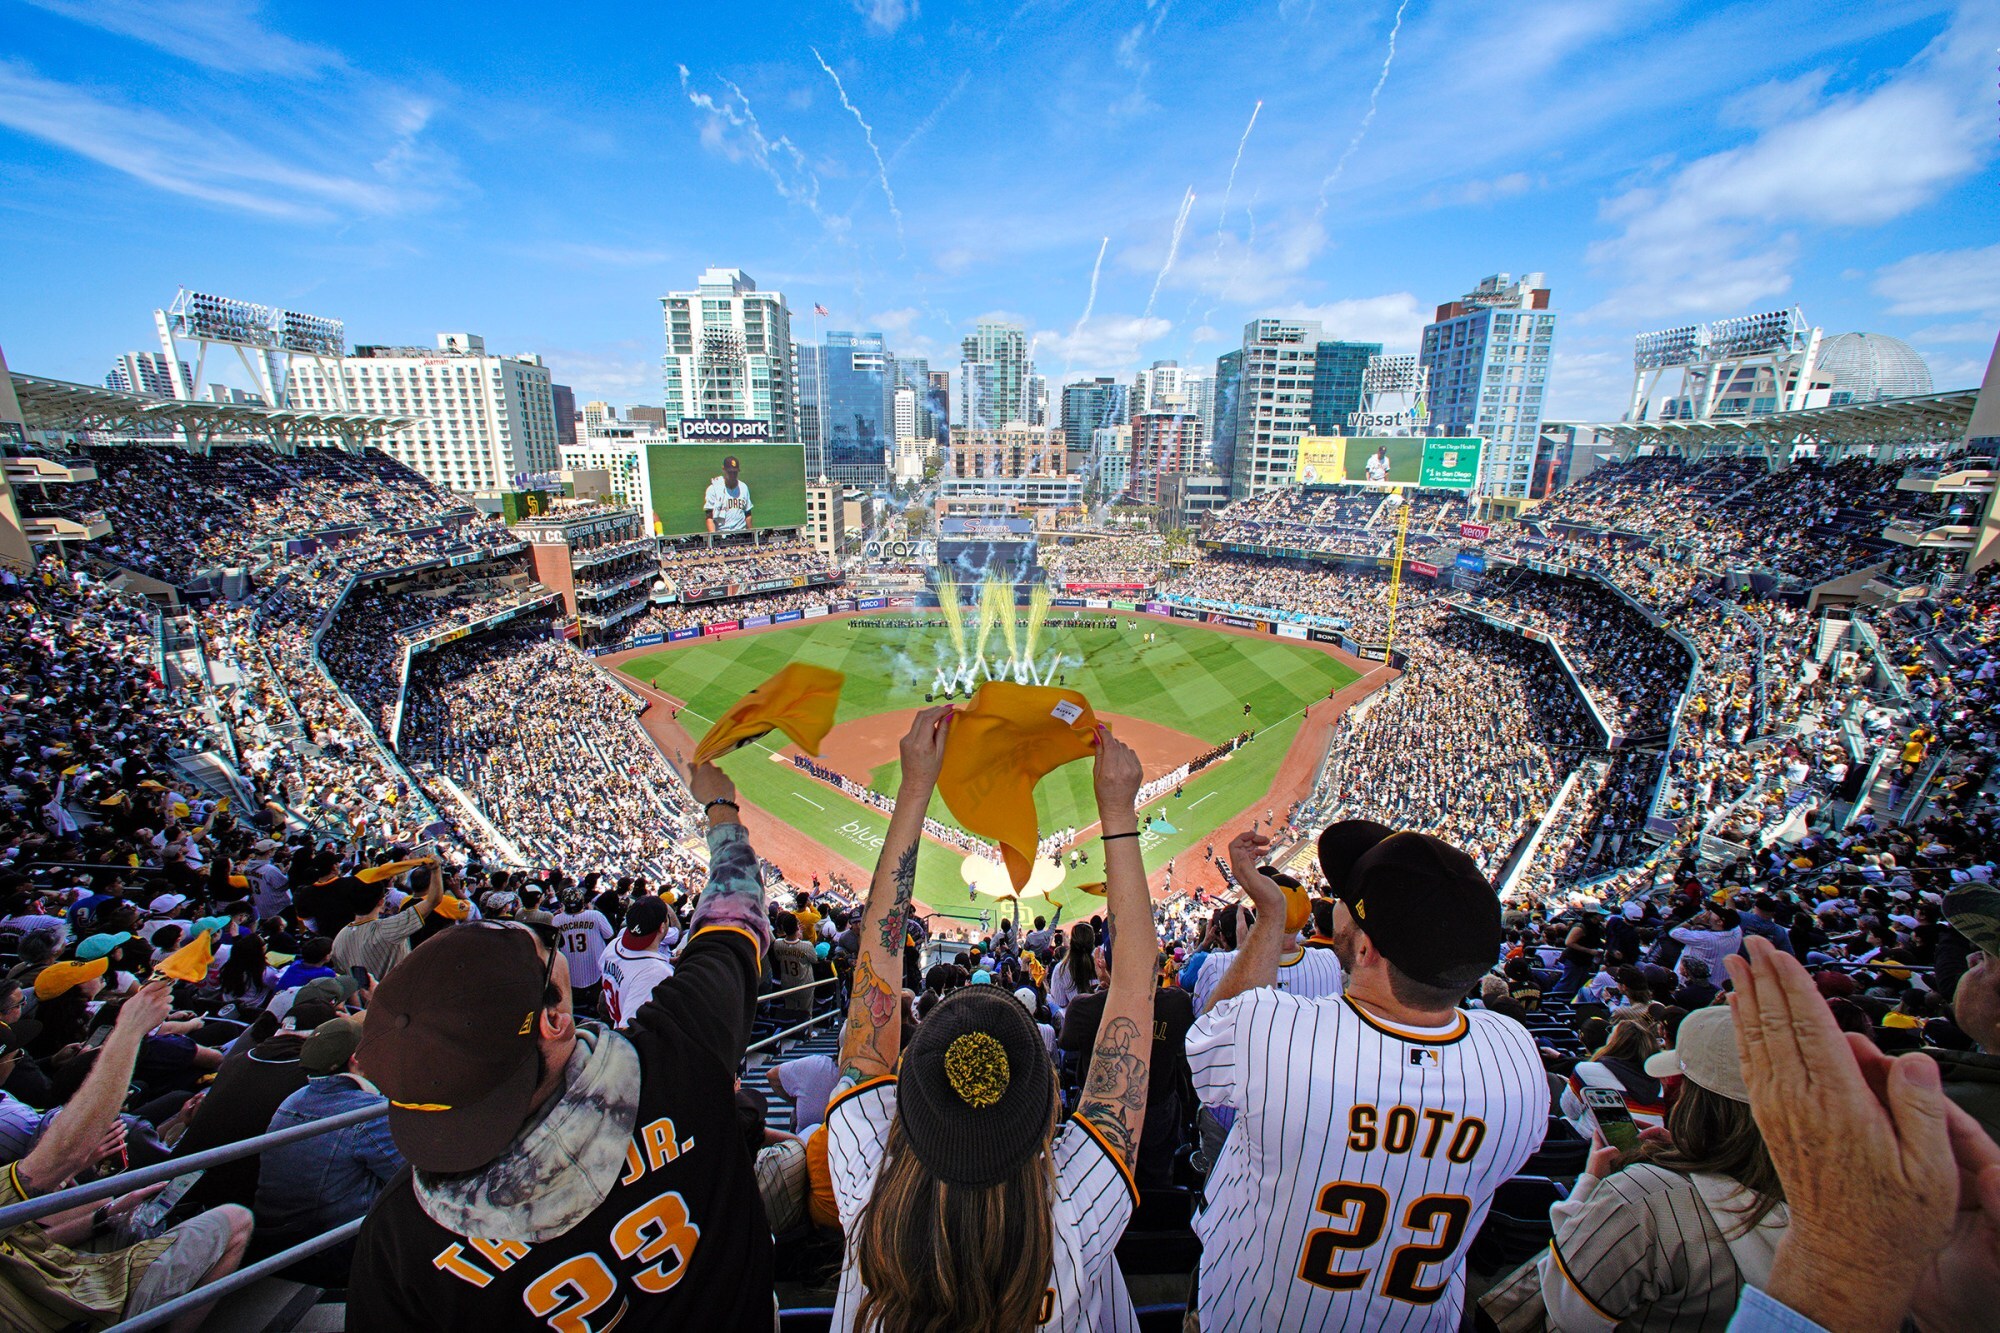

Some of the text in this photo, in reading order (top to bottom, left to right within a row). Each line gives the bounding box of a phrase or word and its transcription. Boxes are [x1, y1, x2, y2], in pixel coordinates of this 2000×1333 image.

[683, 420, 768, 438] petco park
[1349, 412, 1402, 427] Viasat
[567, 524, 595, 539] WESTERN
[595, 520, 612, 533] METAL
[612, 517, 631, 529] SUPPLY
[1462, 526, 1486, 539] xerox
[860, 600, 879, 608] ARCO
[834, 828, 874, 851] CALIFORNIA
[840, 820, 887, 848] blue
[568, 933, 587, 952] 13
[784, 960, 799, 977] 13
[1349, 1103, 1487, 1164] SOTO
[622, 1117, 694, 1186] JR.
[1297, 1180, 1472, 1306] 22
[432, 1237, 533, 1288] TA
[523, 1191, 700, 1333] 23
